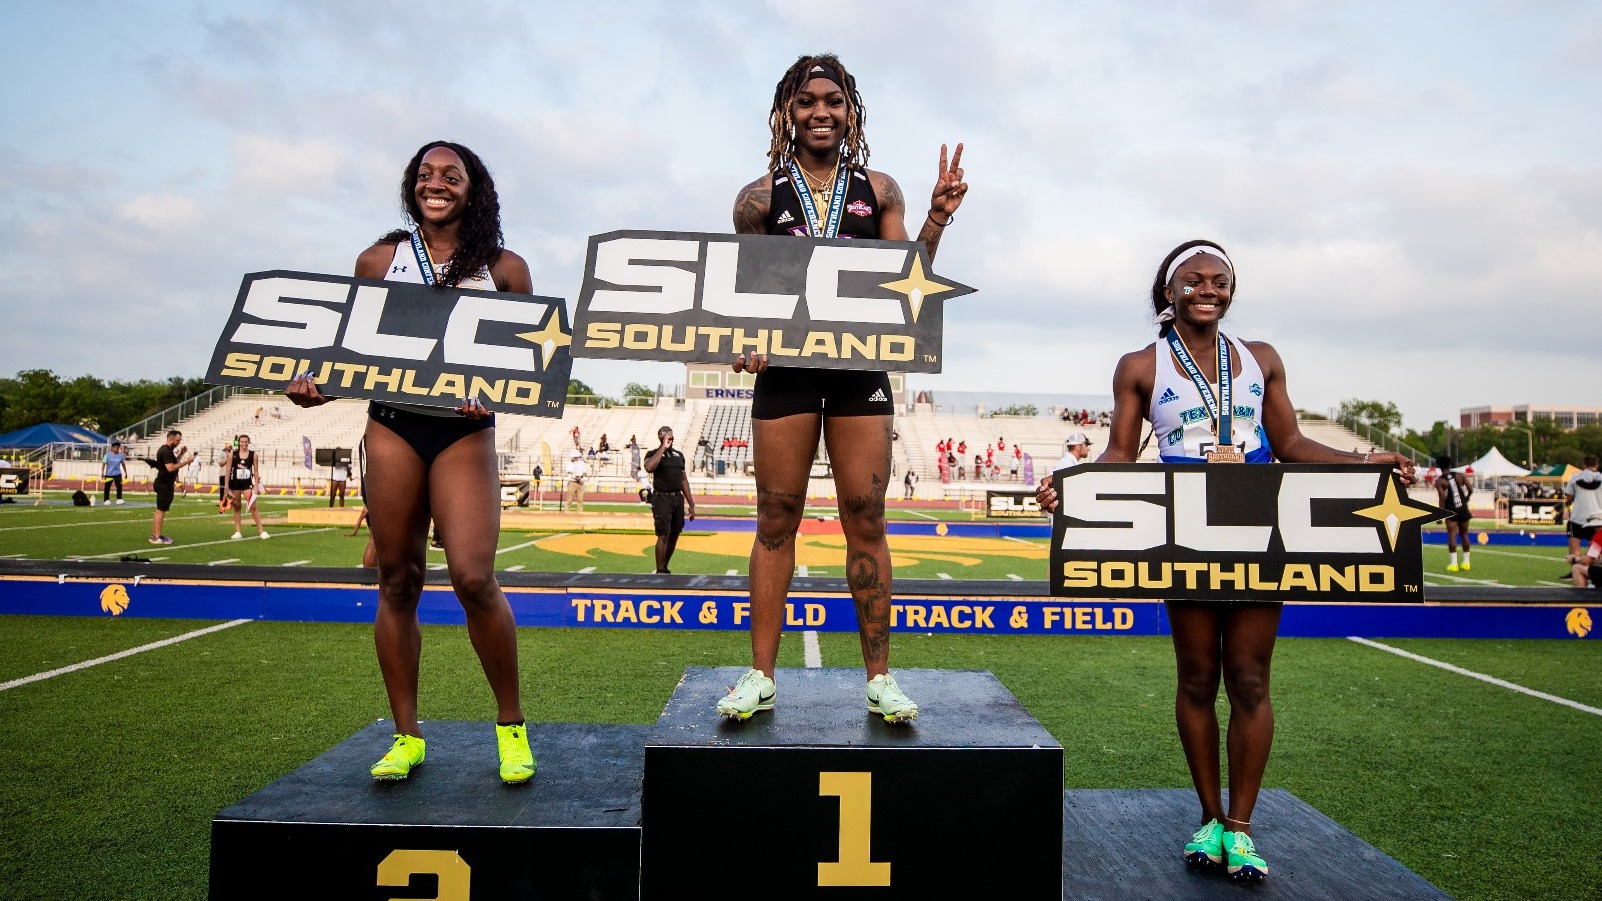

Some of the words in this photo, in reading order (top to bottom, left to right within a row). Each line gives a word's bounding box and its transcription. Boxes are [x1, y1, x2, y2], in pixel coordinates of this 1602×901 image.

[826, 195, 842, 238] SOUTHLAND
[587, 238, 909, 324] SLC
[230, 277, 549, 372] SLC
[585, 322, 915, 361] SOUTHLAND
[923, 355, 937, 363] TM
[1171, 339, 1196, 375] SOUTHLAND
[220, 352, 541, 406] SOUTHLAND
[547, 400, 560, 409] TM
[706, 388, 753, 399] ERNES
[1221, 371, 1230, 416] SOUTHLAND
[1179, 406, 1209, 425] TEX
[990, 496, 1041, 511] SLC
[1061, 472, 1384, 553] SLC
[1511, 505, 1555, 520] SLC
[1063, 561, 1395, 592] SOUTHLAND
[1404, 585, 1418, 593] TM
[571, 599, 684, 624] TRACK
[698, 601, 718, 624] &
[733, 602, 826, 626] FLD
[890, 605, 995, 628] TRACK
[1009, 605, 1028, 628] &
[1042, 607, 1134, 629] FIELD
[818, 772, 891, 886] 1
